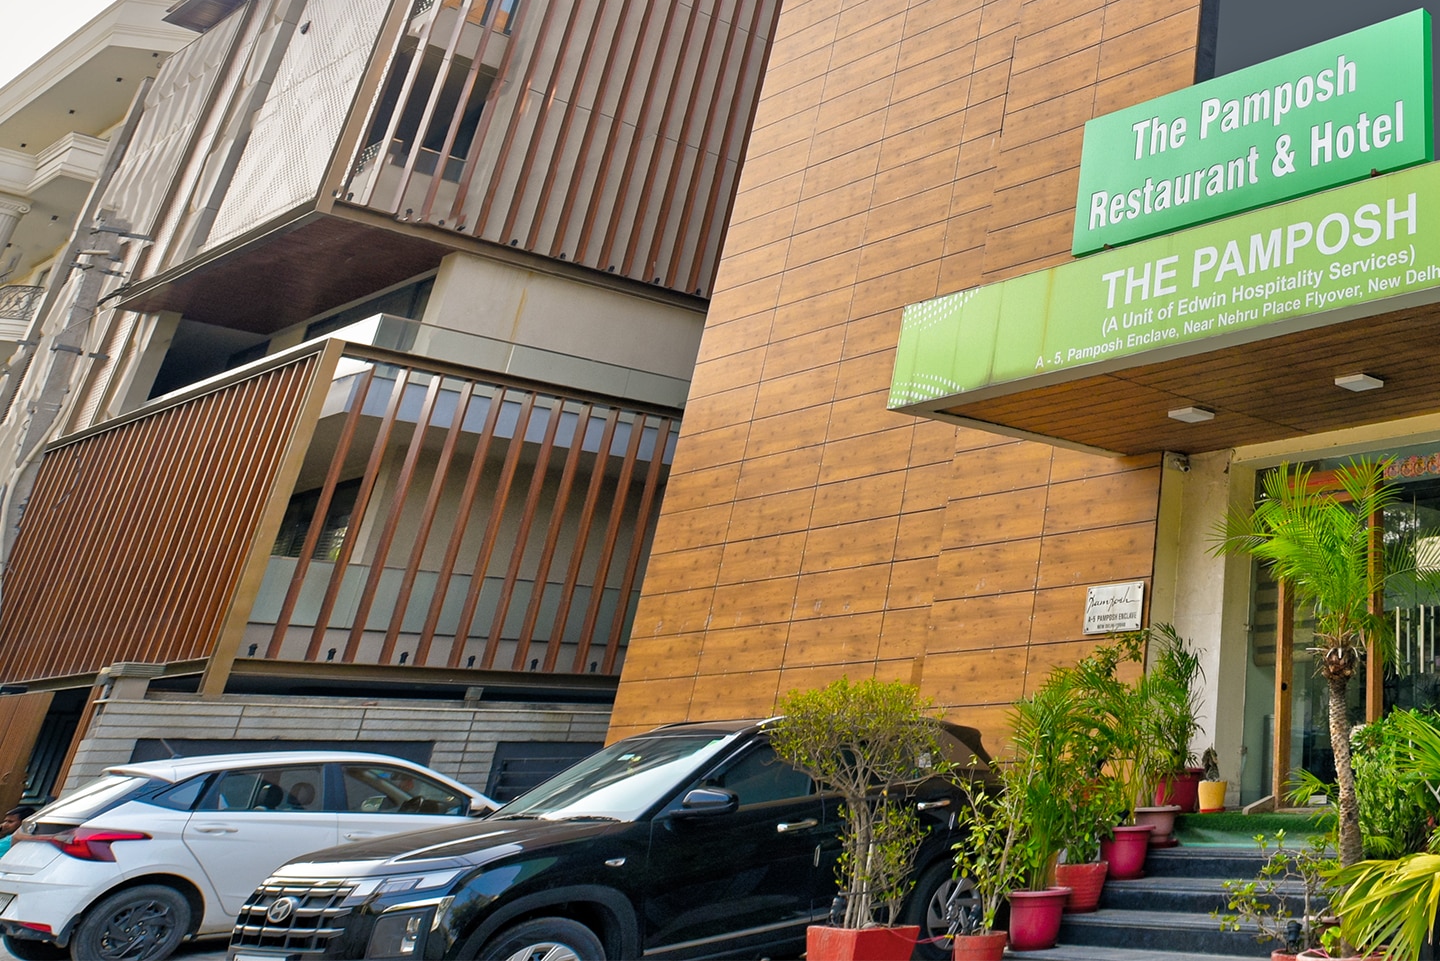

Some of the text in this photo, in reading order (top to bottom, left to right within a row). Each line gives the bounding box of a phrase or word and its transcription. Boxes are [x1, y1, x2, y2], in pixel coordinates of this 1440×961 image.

[1132, 54, 1357, 160] The Pamposh
[1088, 100, 1404, 230] Restaurant & Hotel
[1101, 244, 1416, 337] (A Unit of Edwin Hospitality Services)
[1102, 192, 1417, 309] THE PAMPOSH
[1035, 355, 1044, 369] A
[1054, 351, 1064, 365] 5,
[1067, 336, 1123, 362] Pamposh
[1127, 326, 1180, 348] Enclave,
[1183, 317, 1214, 336] Near
[1218, 307, 1259, 327] Nehru
[1262, 298, 1301, 317] Place
[1305, 284, 1364, 308] Flyover,
[1367, 275, 1401, 294] New
[1097, 613, 1117, 622] PAMPOSH
[1119, 611, 1137, 621] ENCLAVE
